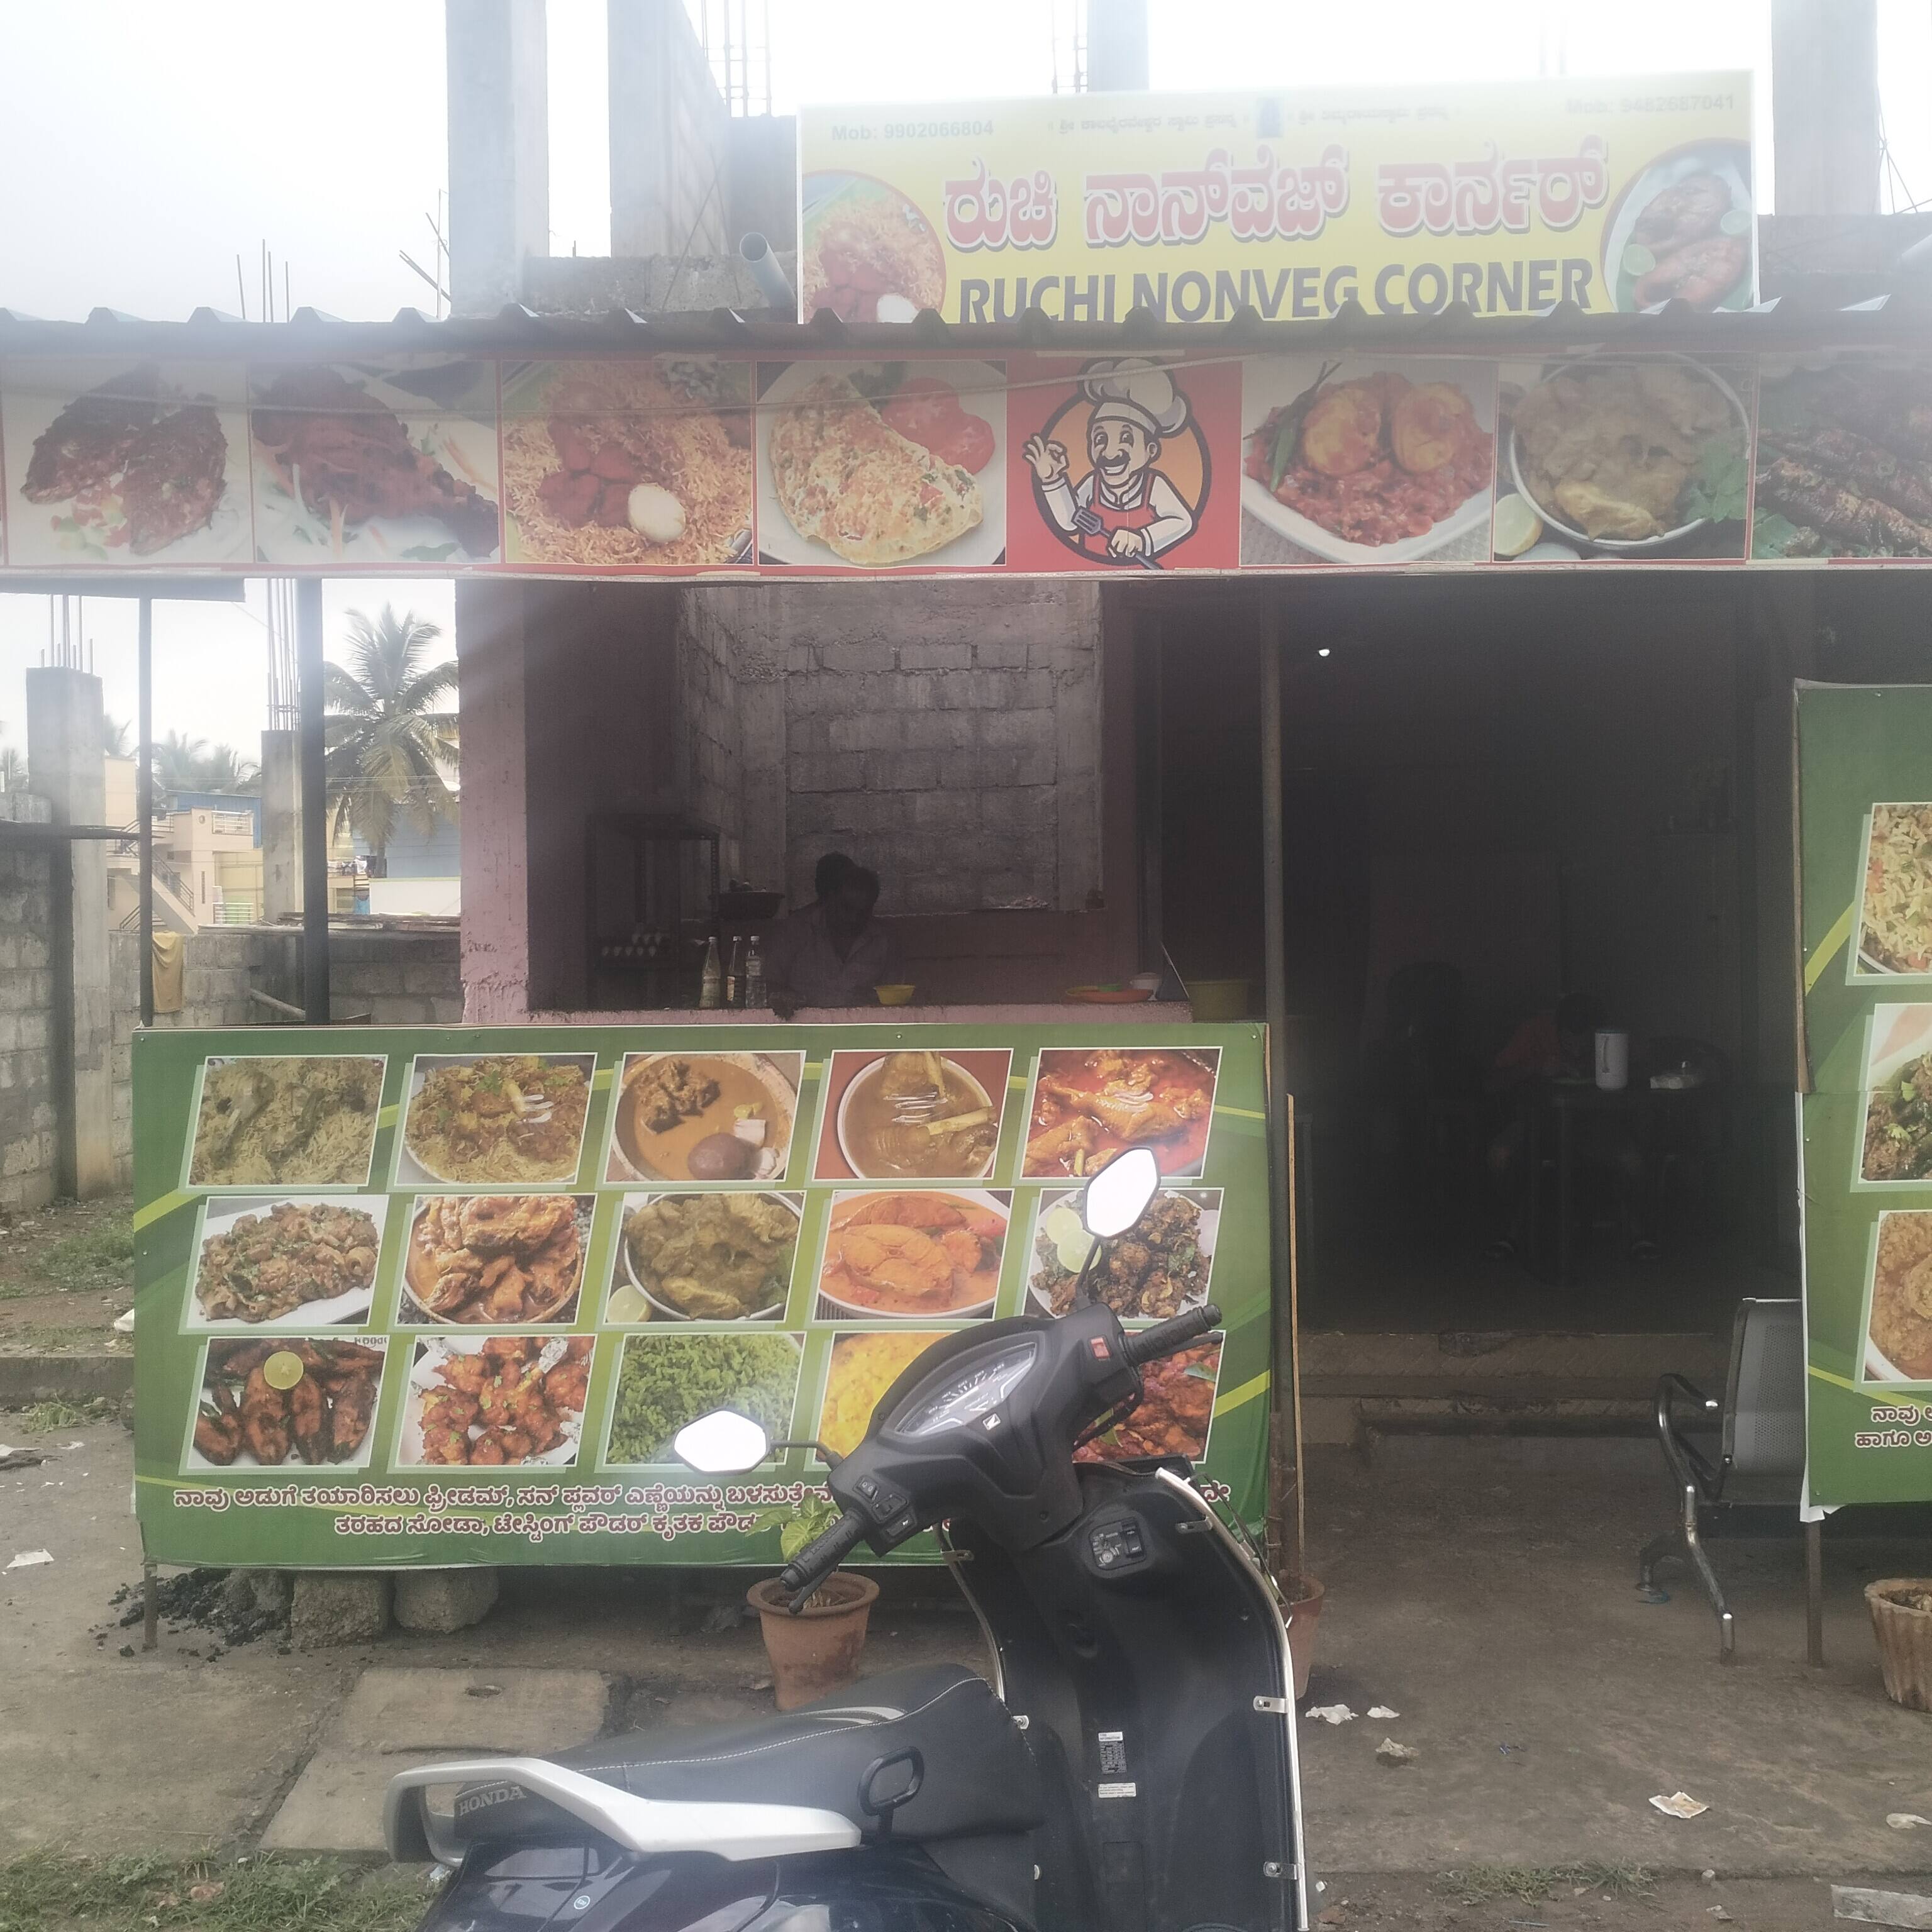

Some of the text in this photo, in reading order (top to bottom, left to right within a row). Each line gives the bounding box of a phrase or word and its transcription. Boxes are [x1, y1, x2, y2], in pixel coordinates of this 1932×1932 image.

[831, 119, 994, 142] Mob: 9902066804
[945, 155, 1057, 249] ರುಚಿ
[1379, 133, 1608, 235] ಕಾರ್ನರ್
[960, 258, 1594, 323] RUCHI NONVEG CORNER
[1872, 1404, 1921, 1426] ನಾವು
[1855, 1430, 1911, 1448] ಹಾಗೂ
[174, 1487, 229, 1512] ನಾವು
[235, 1485, 297, 1506] ಅಡುಗೆ
[303, 1483, 419, 1506] ತಯಾರಿಸಲು
[517, 1484, 559, 1505] ಸನ್
[625, 1482, 726, 1513] ಎಣ್ಣೆಯನ್ನು
[335, 1514, 403, 1535] ತರಹದ
[407, 1512, 489, 1536] ಸೋಡಾ,
[493, 1511, 575, 1543] ಟೇಸ್ಟಿಂಗ್
[578, 1512, 648, 1532] ಪೌಡರ್
[652, 1514, 704, 1541] ಕೃತಕ
[458, 1786, 527, 1816] HONDA
